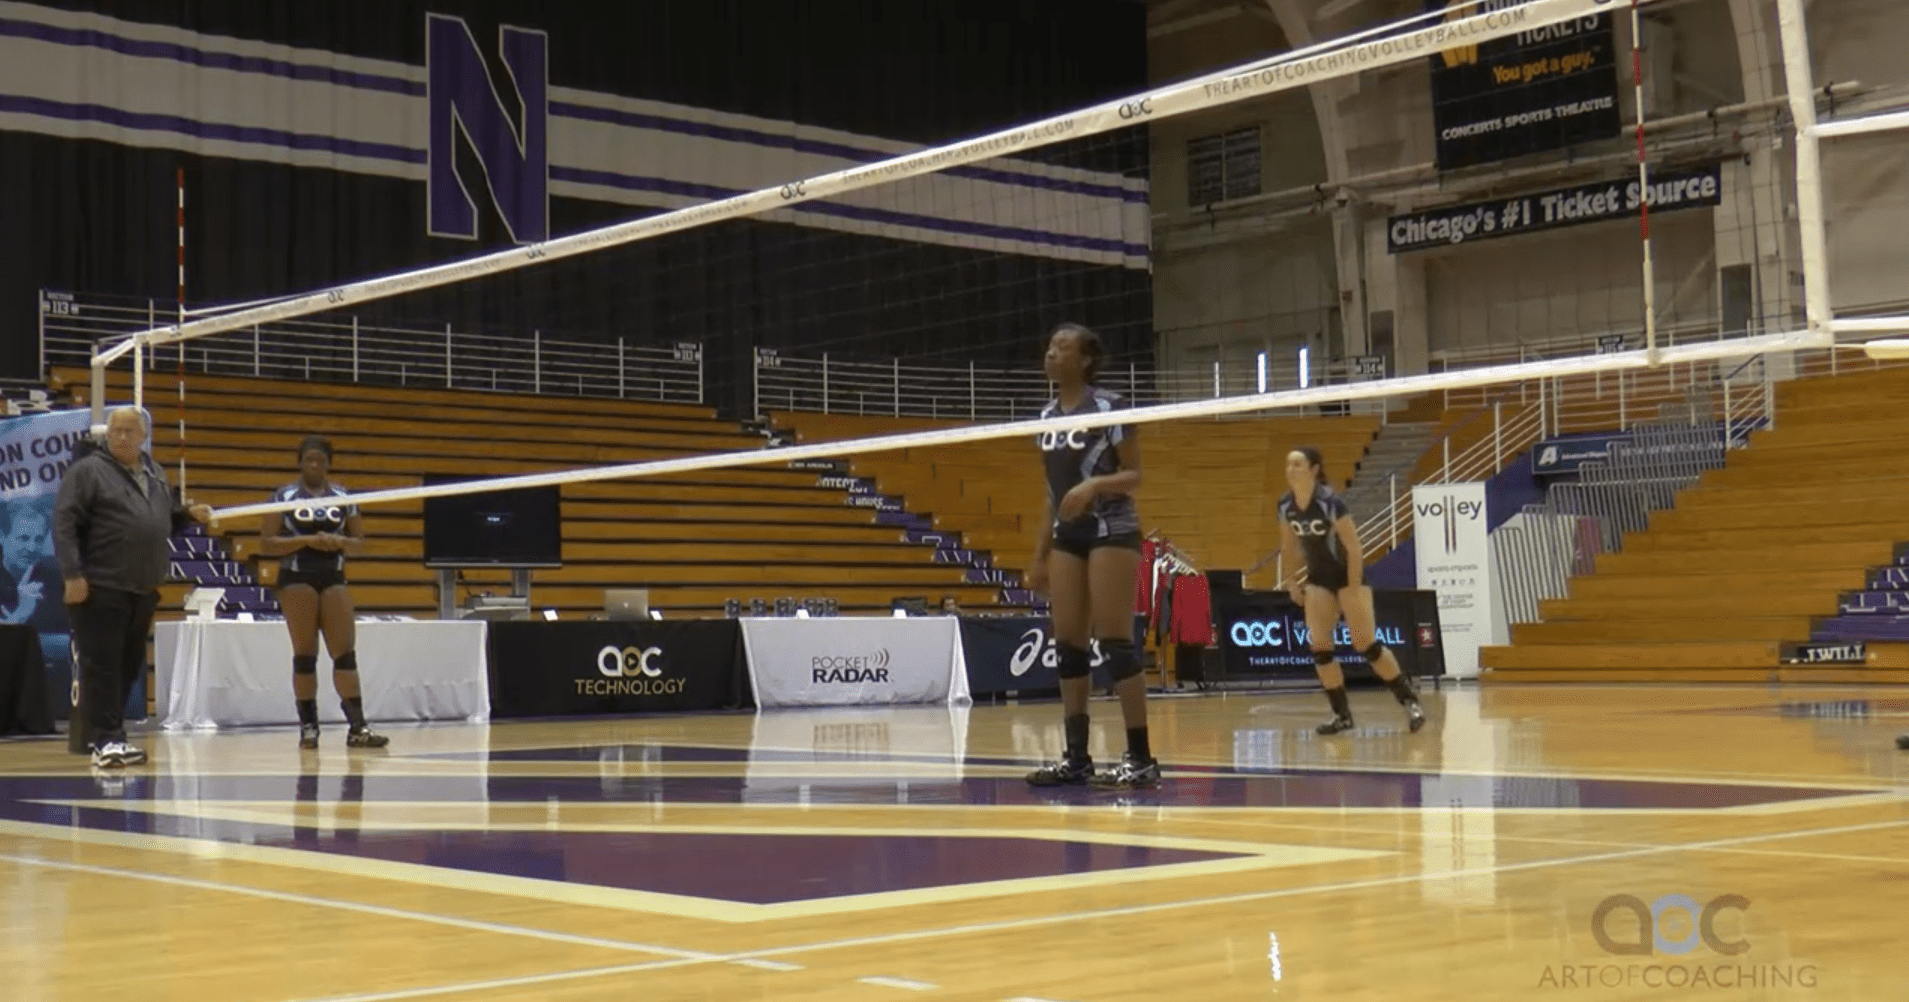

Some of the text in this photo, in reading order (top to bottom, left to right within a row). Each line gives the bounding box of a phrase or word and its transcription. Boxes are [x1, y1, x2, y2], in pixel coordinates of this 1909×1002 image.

[1492, 65, 1520, 84] You
[1522, 58, 1548, 83] got
[1550, 58, 1560, 72] a
[425, 11, 548, 245] N
[1442, 96, 1613, 140] CONCERTS SPORTS THEATRE
[1391, 174, 1716, 246] Chicago's #1 Ticket Source
[52, 300, 69, 315] 113
[812, 656, 868, 670] POCKET
[575, 677, 686, 695] TECHNOLOGY
[813, 668, 888, 684] RADAR
